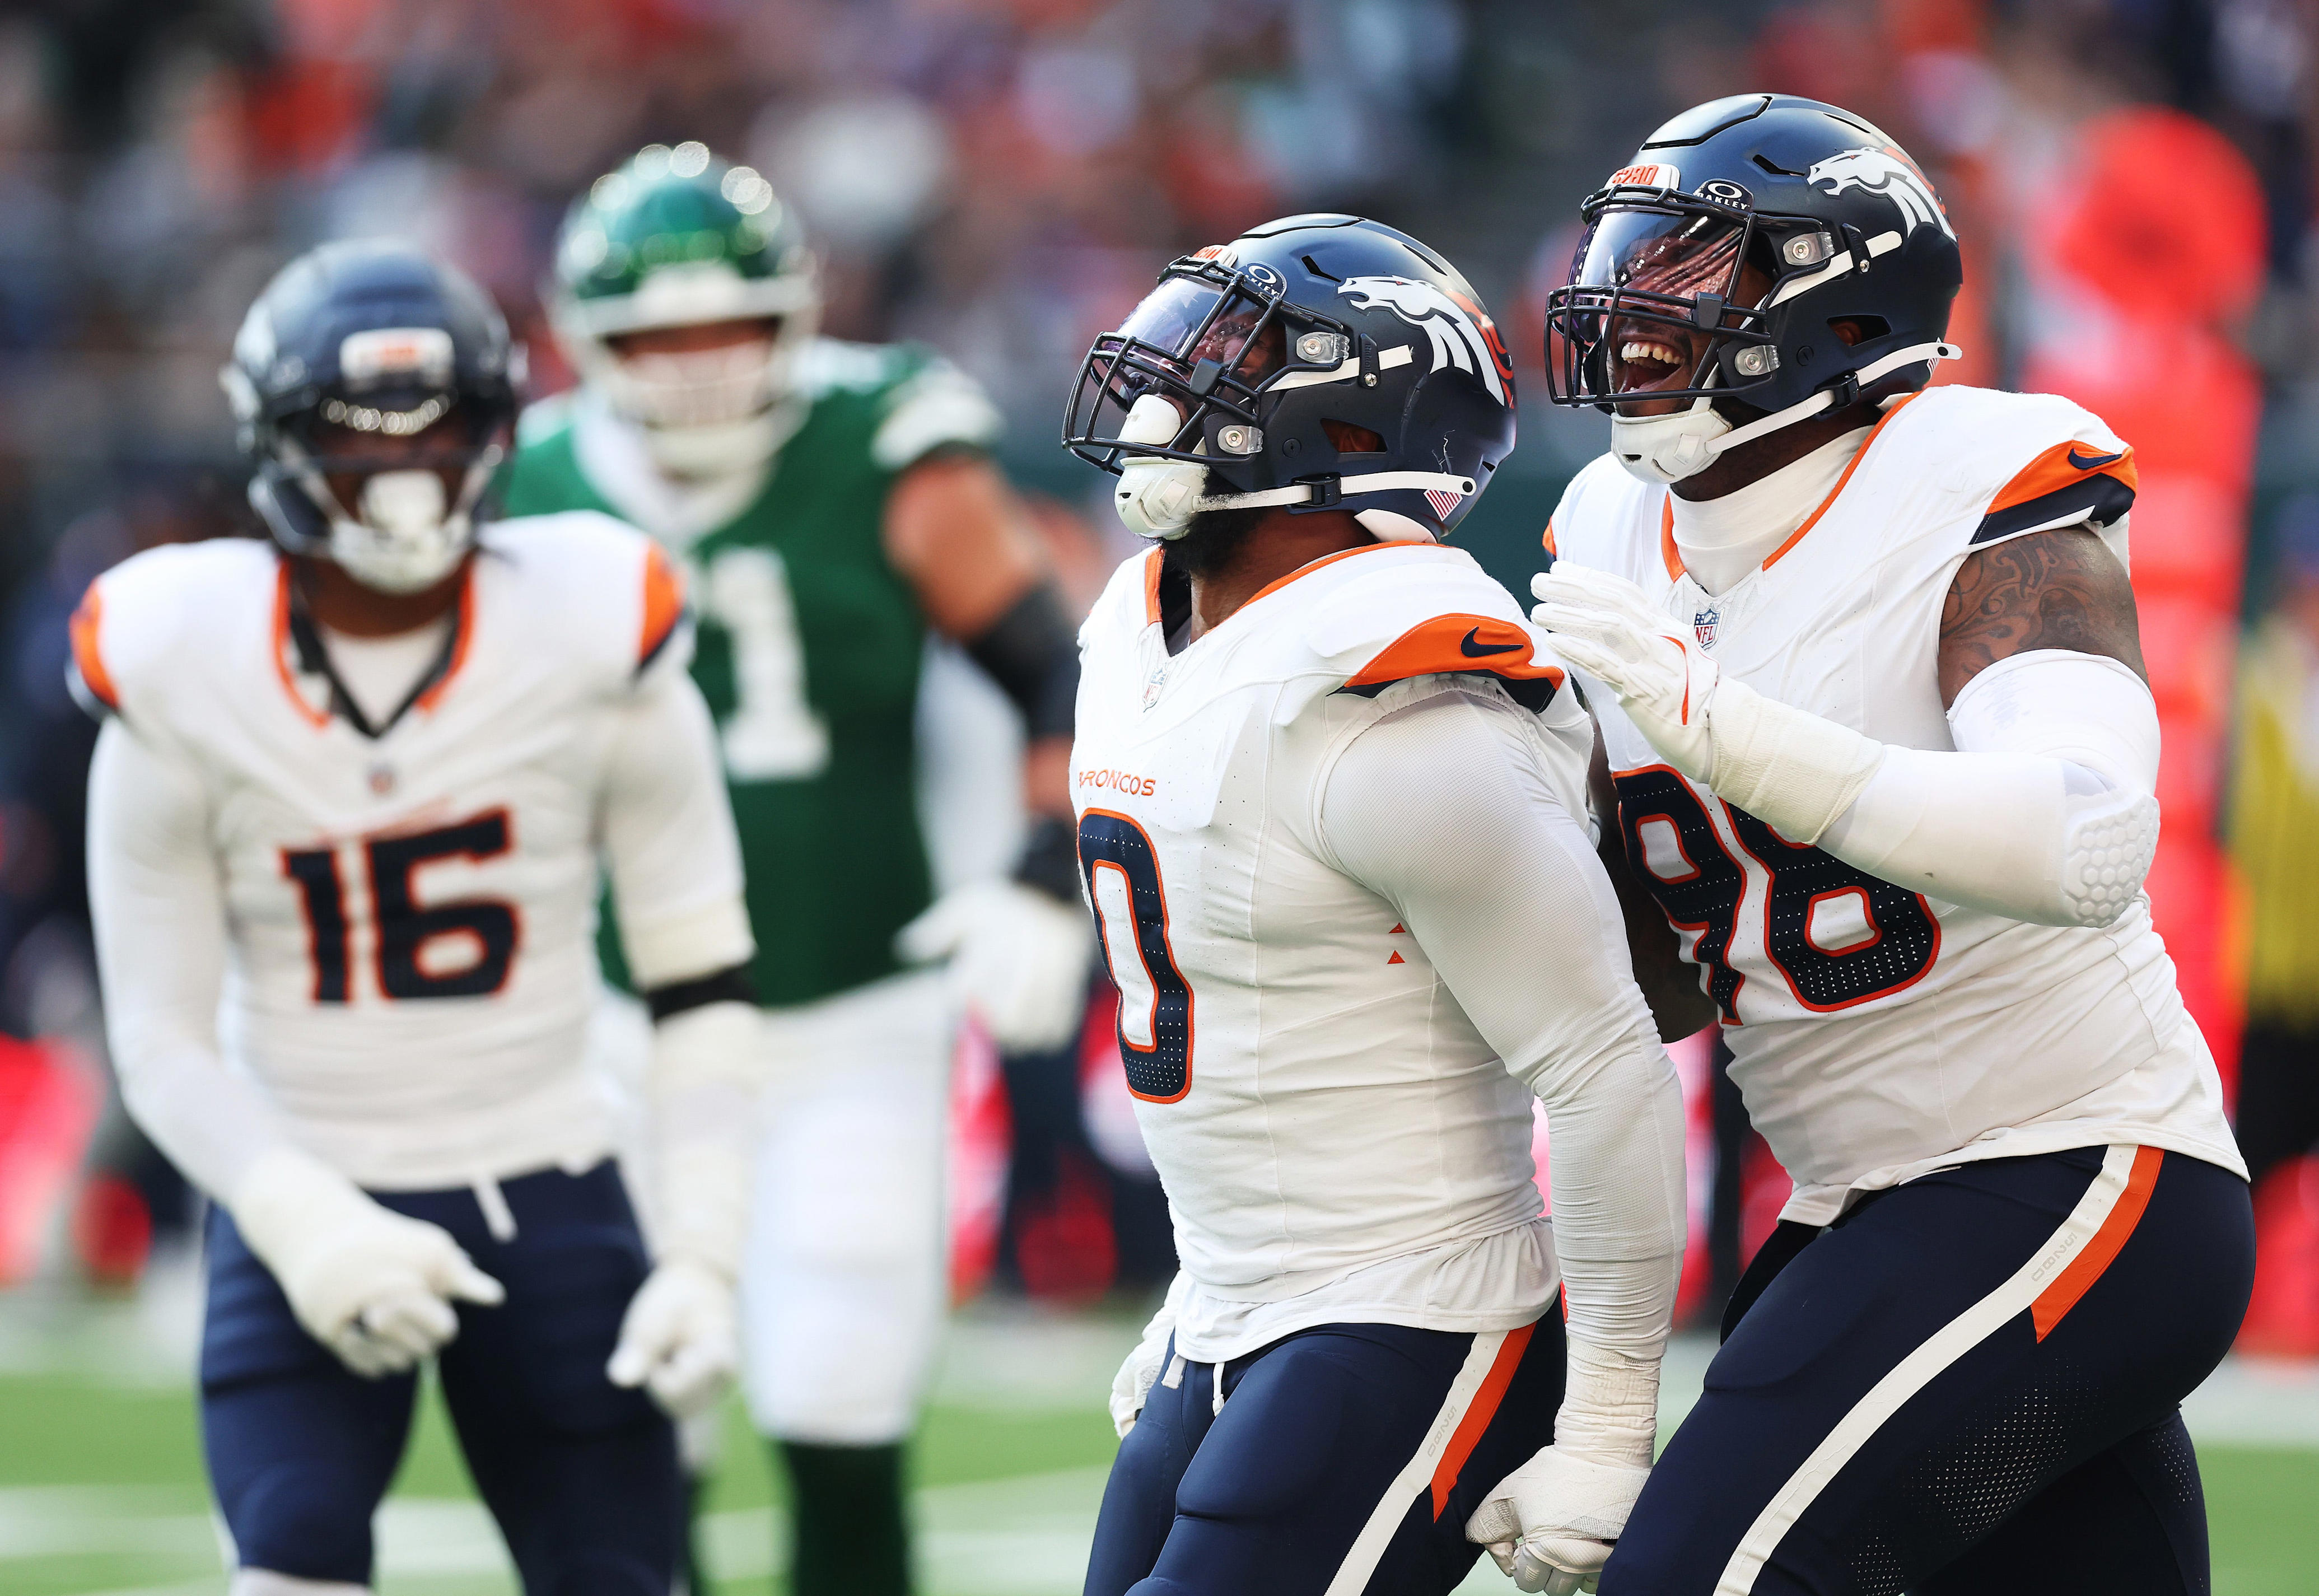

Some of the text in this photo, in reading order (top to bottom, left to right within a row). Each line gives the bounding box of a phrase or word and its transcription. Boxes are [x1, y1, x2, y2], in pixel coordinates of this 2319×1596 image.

[1612, 165, 1659, 185] 5280
[693, 543, 832, 784] 1
[1695, 626, 1714, 644] NFL
[280, 804, 521, 1006] 16
[1077, 807, 1195, 1104] 0
